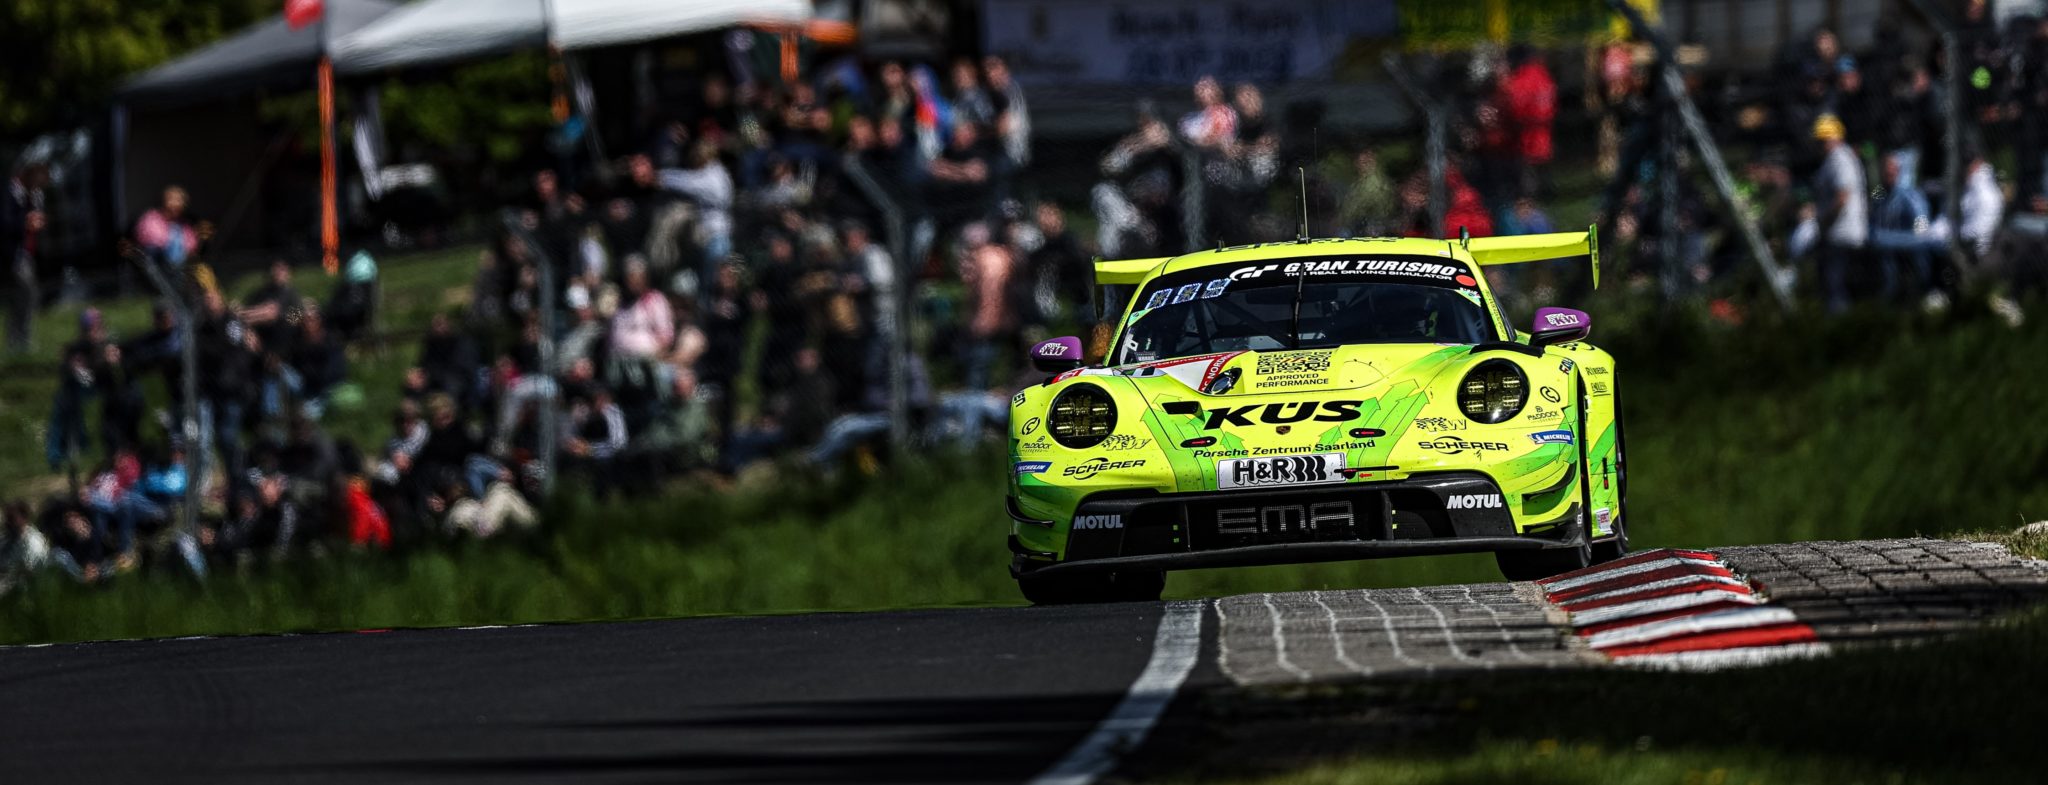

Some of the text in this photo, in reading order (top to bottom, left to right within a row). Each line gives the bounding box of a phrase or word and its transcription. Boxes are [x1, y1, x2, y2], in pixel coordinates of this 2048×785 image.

[1283, 260, 1458, 276] GRAN TURISMO
[1388, 270, 1453, 281] SIMULATOR
[1256, 378, 1329, 388] PERFORMANCE
[1266, 373, 1319, 381] APPROVED
[1203, 400, 1364, 430] KÜS
[1542, 433, 1571, 441] MICHELIN
[1193, 440, 1376, 458] Porsche Zentrum Saarland
[1417, 440, 1509, 452] SCHERER
[1062, 459, 1146, 477] SCHERER
[1233, 455, 1297, 485] H&R
[1447, 493, 1503, 509] MOTUL
[1073, 514, 1124, 529] MOTUL
[1217, 500, 1355, 534] EMA
